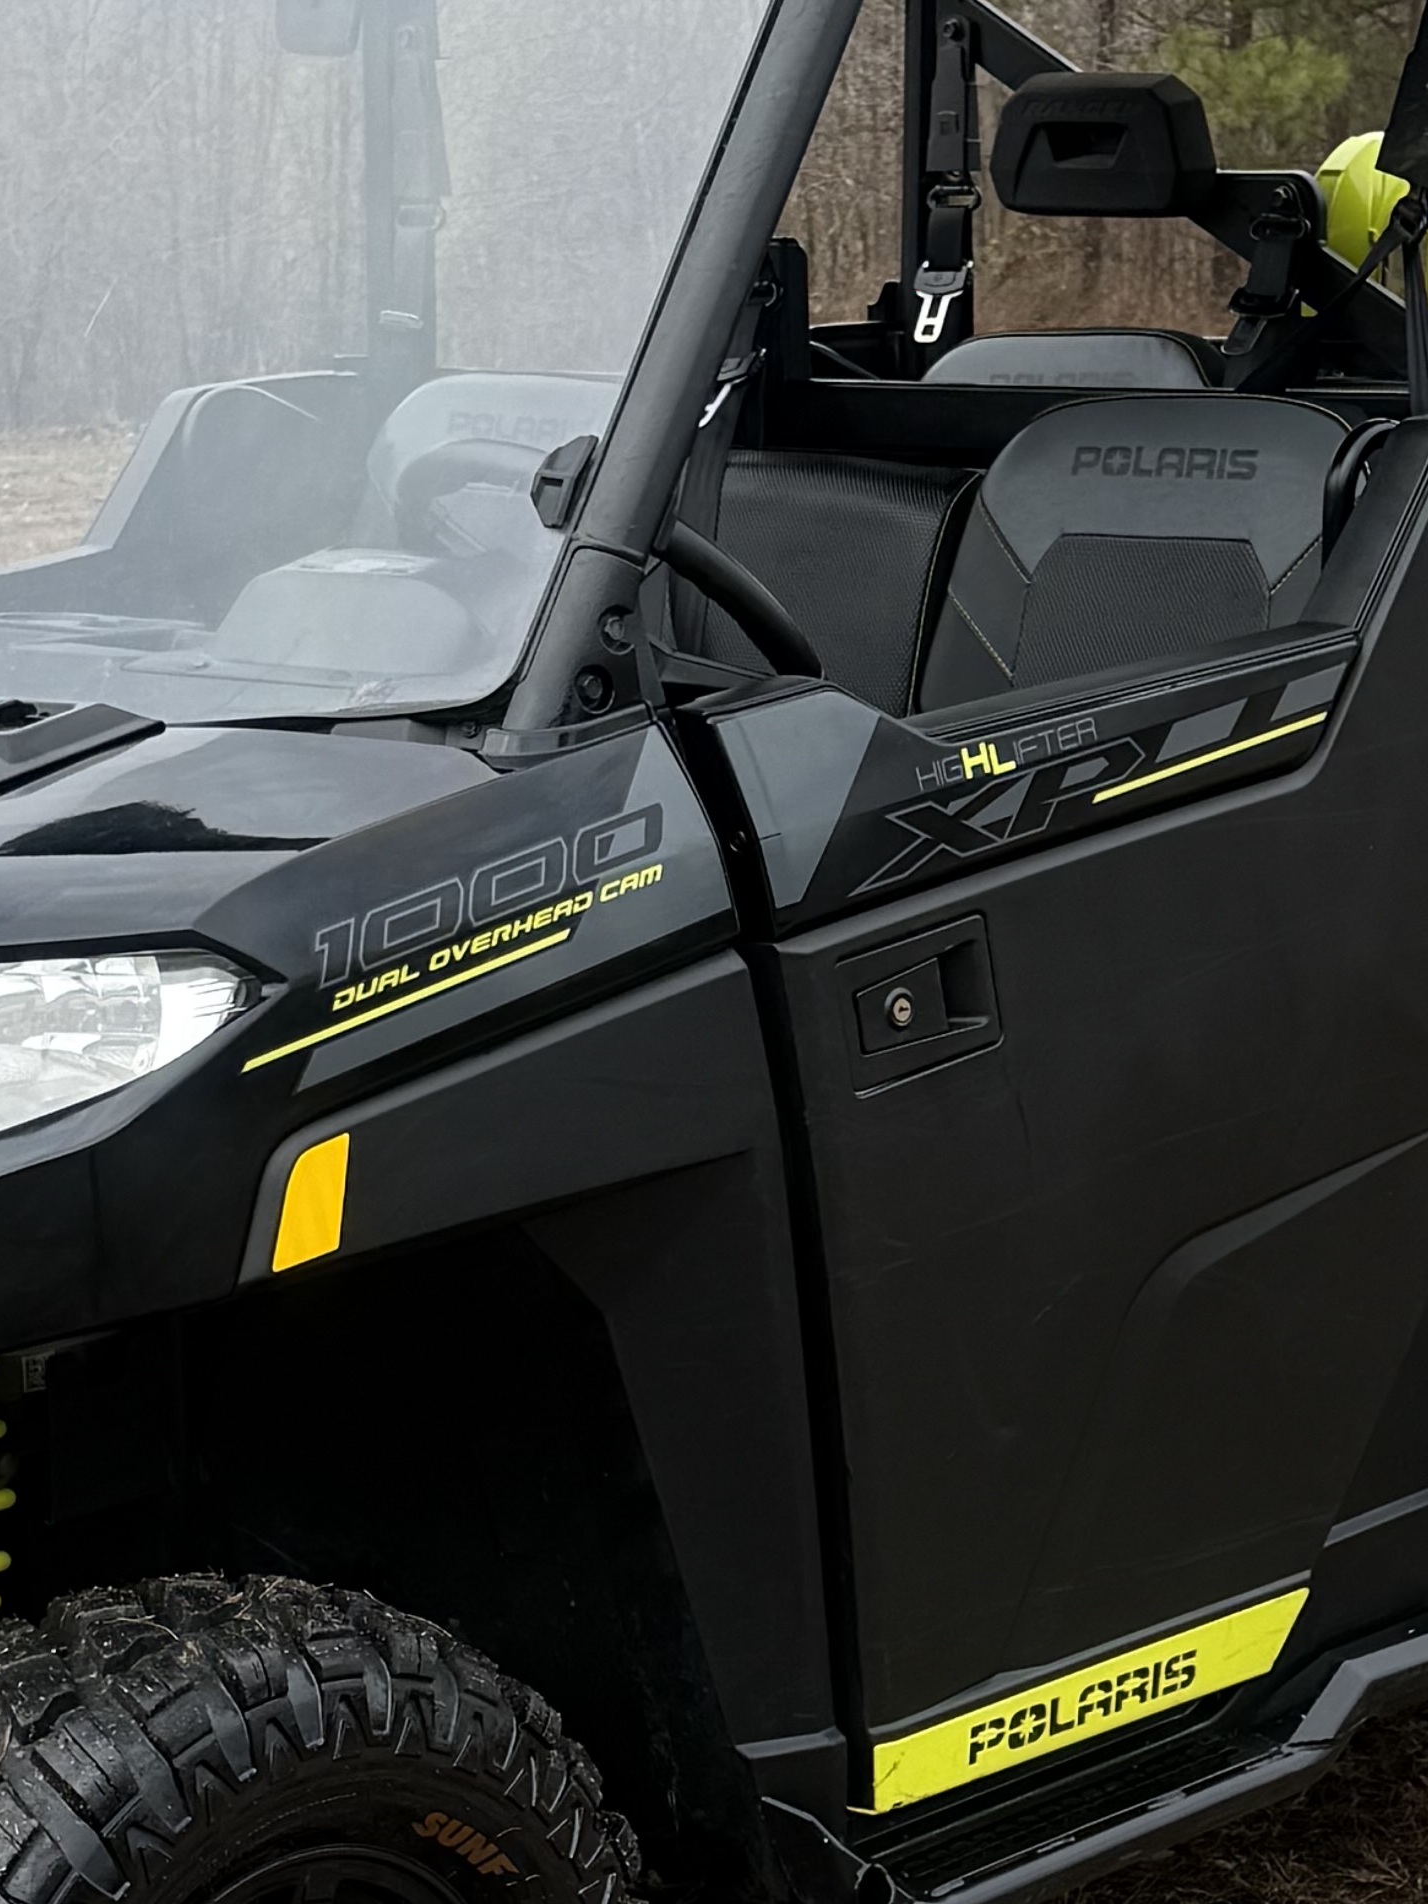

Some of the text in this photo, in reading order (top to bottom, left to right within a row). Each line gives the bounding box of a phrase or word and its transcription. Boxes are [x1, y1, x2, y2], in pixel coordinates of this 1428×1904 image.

[1070, 446, 1260, 481] POLARIS
[848, 738, 1146, 897] XP
[315, 803, 663, 989] 1000
[332, 863, 664, 1012] DUAL OVERHEAD CAM
[968, 1649, 1198, 1767] POLARIS
[413, 1812, 519, 1876] SUNF
